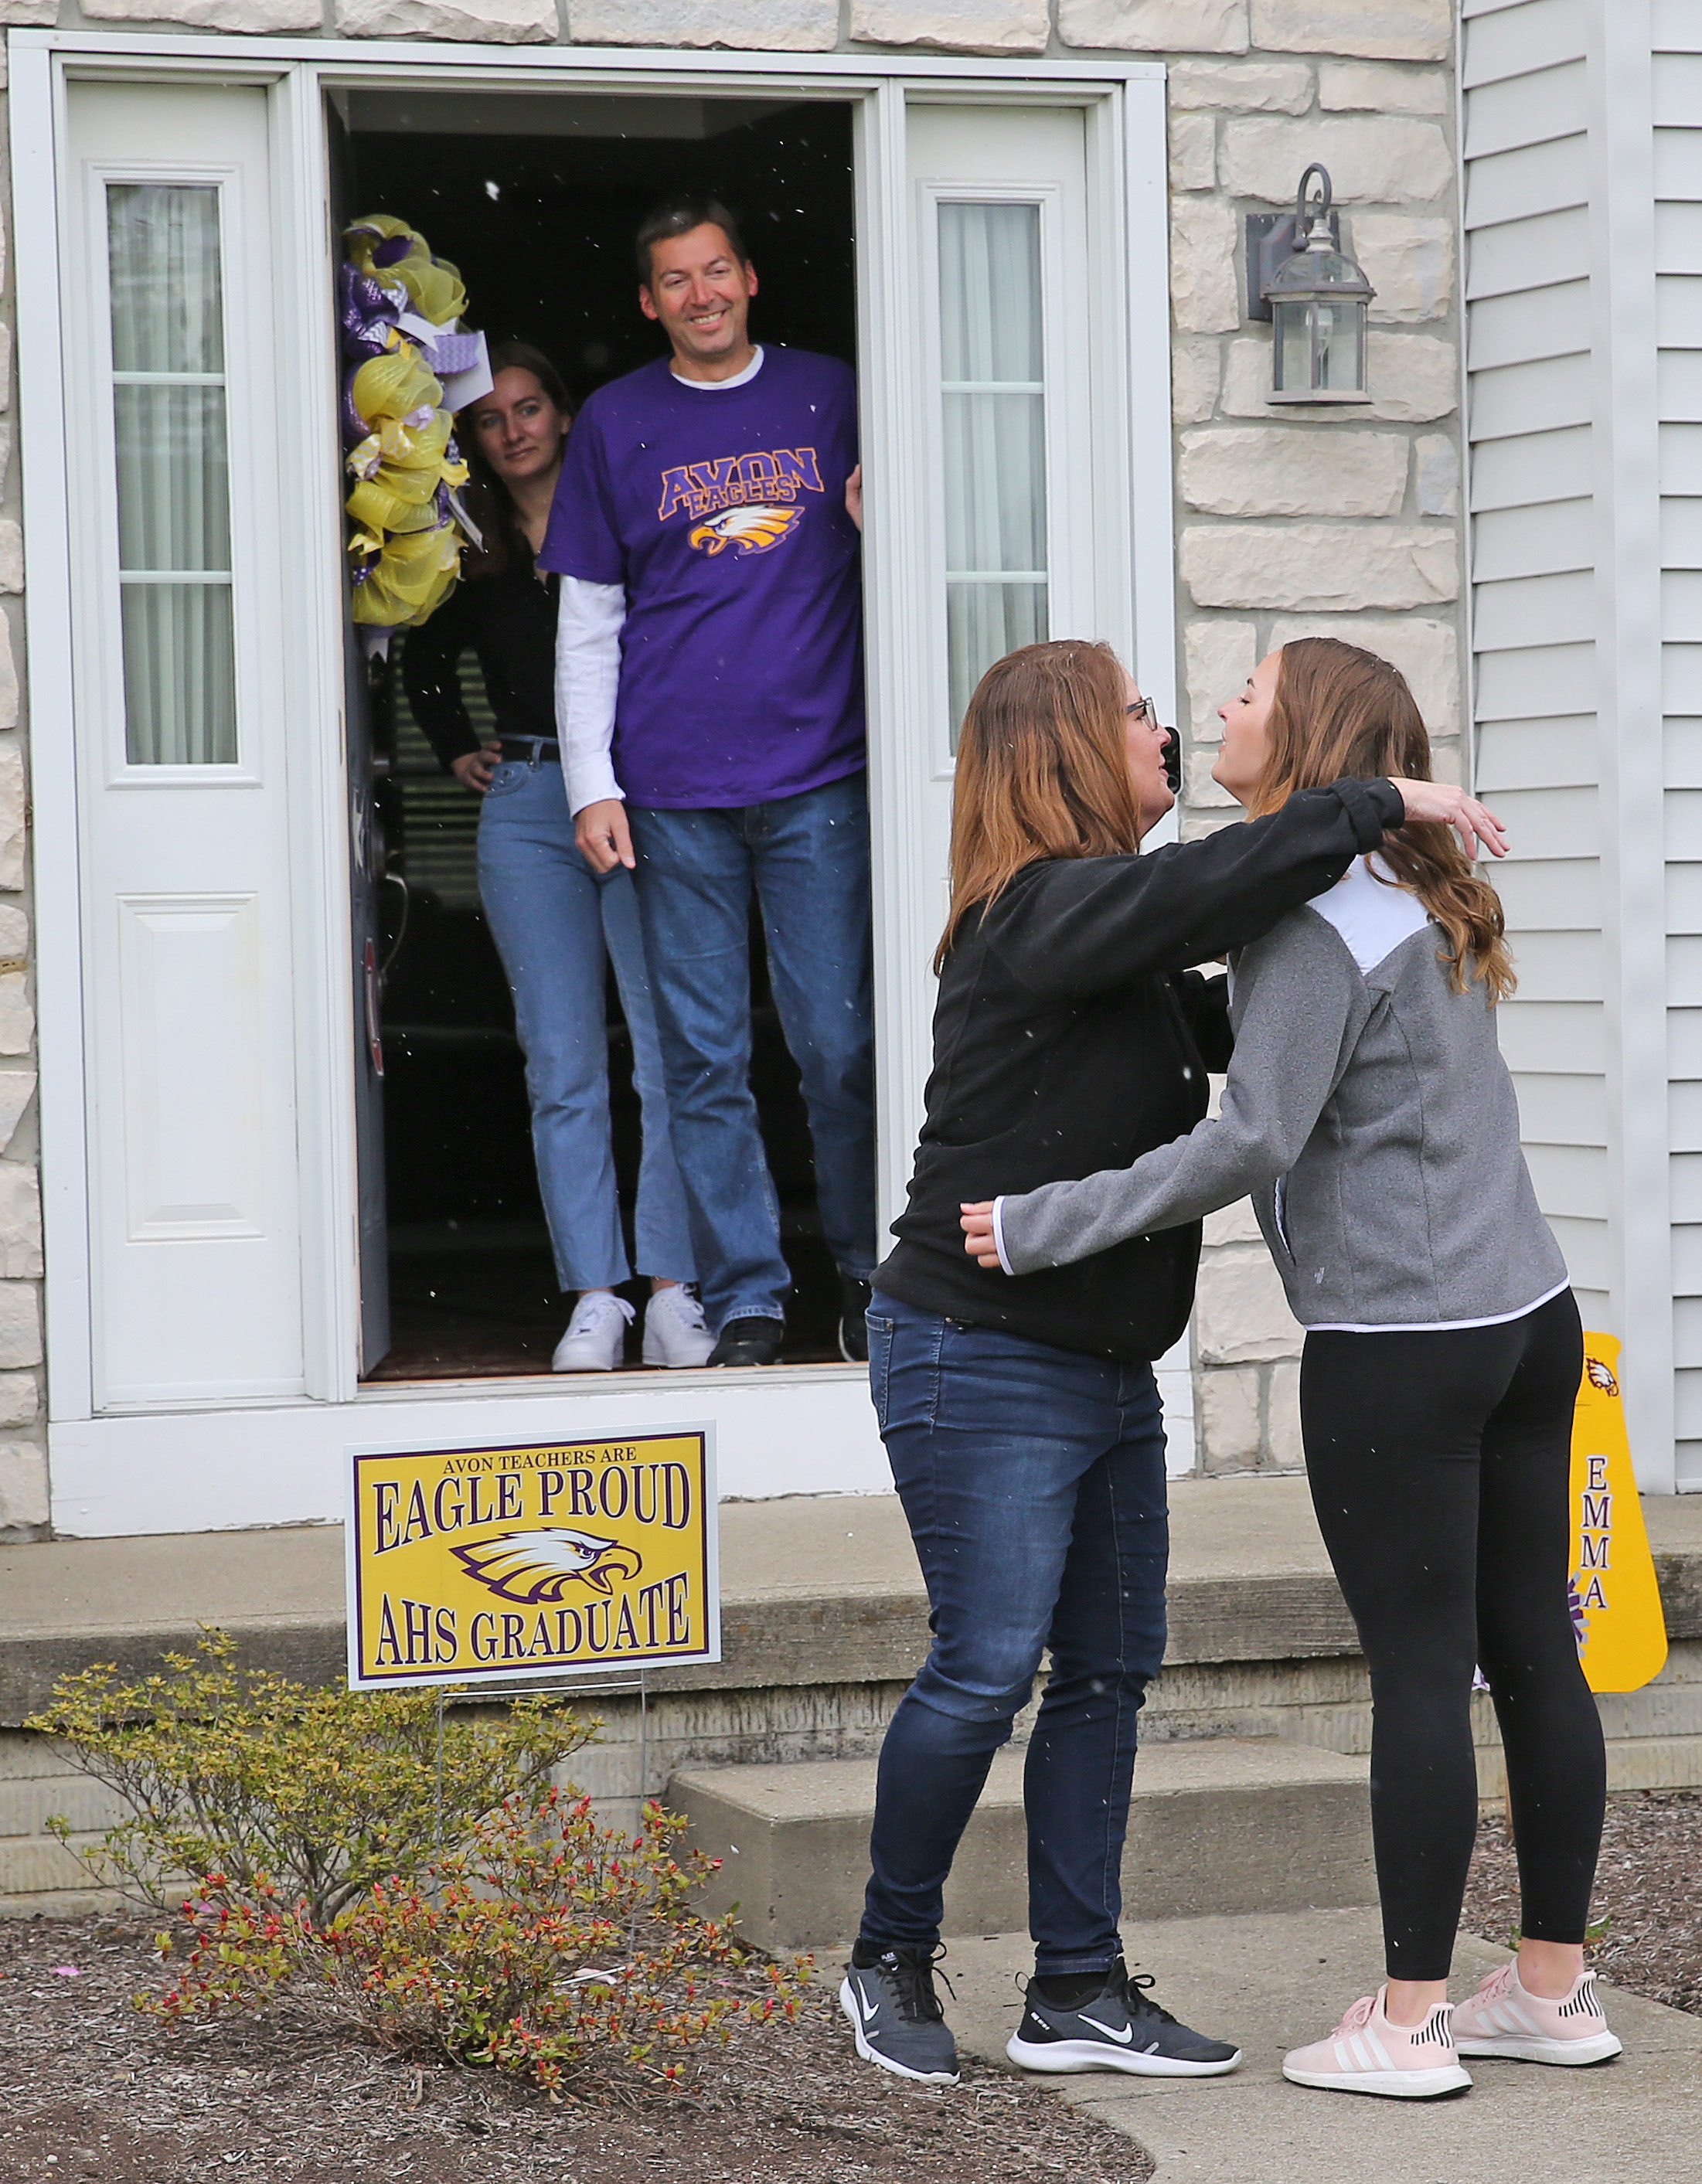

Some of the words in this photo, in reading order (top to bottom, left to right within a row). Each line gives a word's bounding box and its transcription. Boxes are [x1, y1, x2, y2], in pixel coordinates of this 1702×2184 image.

[658, 447, 825, 521] AVON
[685, 475, 797, 520] EAGLES
[443, 1457, 494, 1474] AVON
[498, 1449, 596, 1471] TEACHERS
[600, 1447, 638, 1463] ARE
[373, 1471, 523, 1556] EAGLE
[536, 1461, 691, 1531] PROUD
[1579, 1454, 1614, 1611] EMMA
[374, 1592, 458, 1666] AHS
[470, 1571, 691, 1662] GRADUATE
